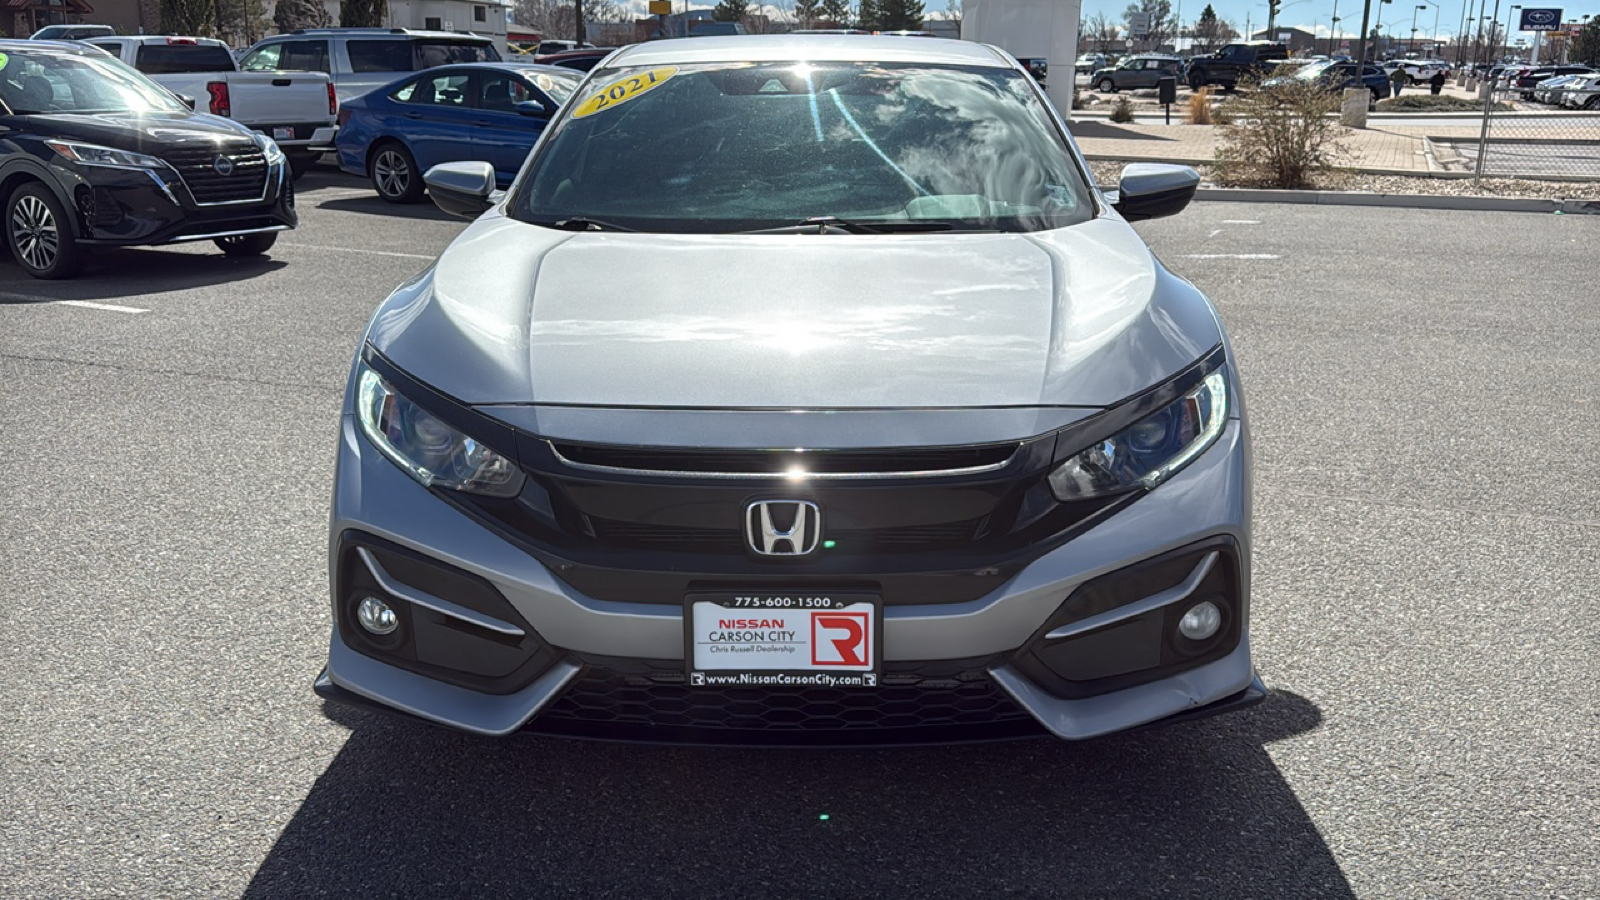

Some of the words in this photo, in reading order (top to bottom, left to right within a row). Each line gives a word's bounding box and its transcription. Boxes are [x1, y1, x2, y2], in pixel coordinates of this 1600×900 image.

[592, 70, 657, 110] 2021
[735, 597, 831, 607] 775-600-1500
[718, 619, 785, 629] NISSAN
[709, 631, 765, 642] CARSON
[768, 631, 796, 642] CITY
[710, 645, 729, 653] Chris
[731, 645, 755, 653] Russell
[756, 645, 796, 654] Dealership
[706, 673, 861, 687] www.NissanCarsonCity.com
